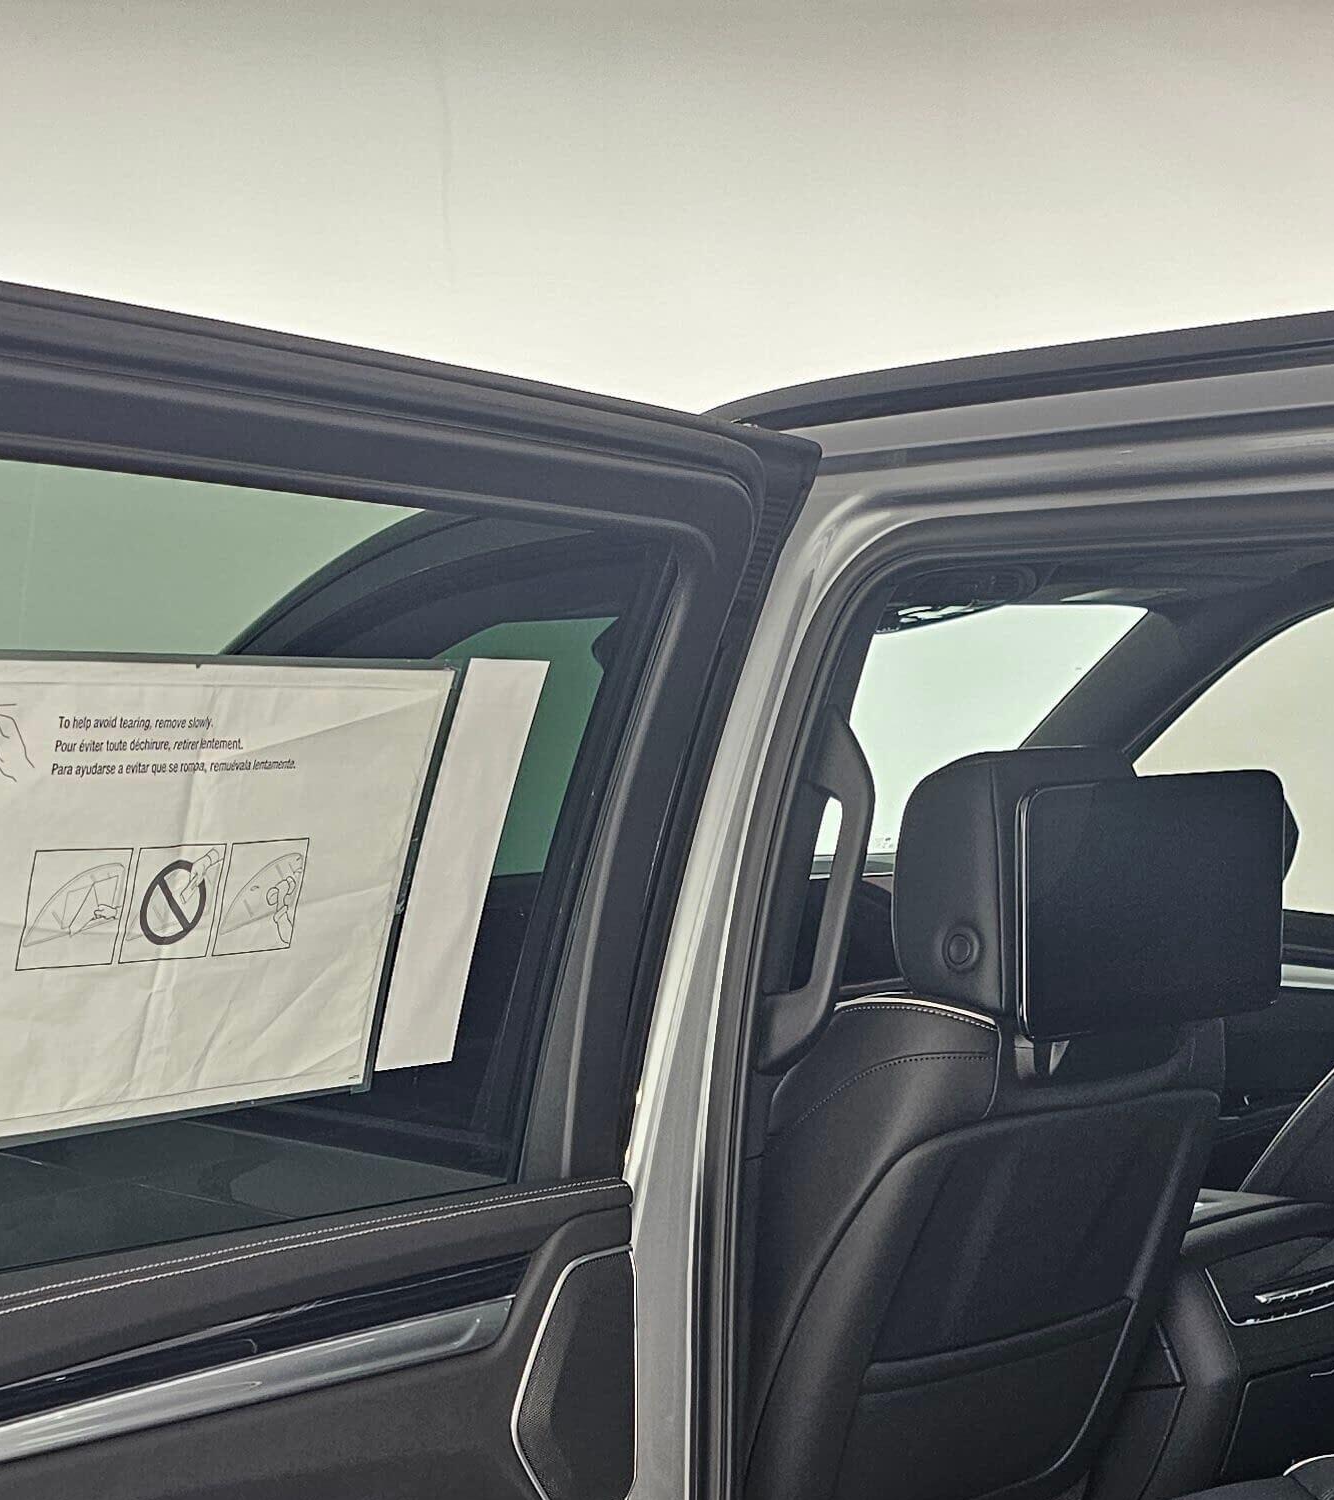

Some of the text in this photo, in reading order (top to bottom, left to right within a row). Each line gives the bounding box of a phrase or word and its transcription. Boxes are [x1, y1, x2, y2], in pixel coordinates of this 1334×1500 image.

[59, 715, 214, 731] To help avoid tearing, remove slowly.
[55, 738, 244, 752] Pour éviter toute déchirure, retirer lentement.
[51, 763, 73, 775] Para
[75, 763, 116, 778] ayudarse
[118, 764, 124, 774] a
[126, 762, 150, 774] evitar
[151, 763, 167, 775] que
[168, 762, 178, 773] se
[180, 761, 207, 774] rompa,
[253, 759, 296, 770] lentamente.
